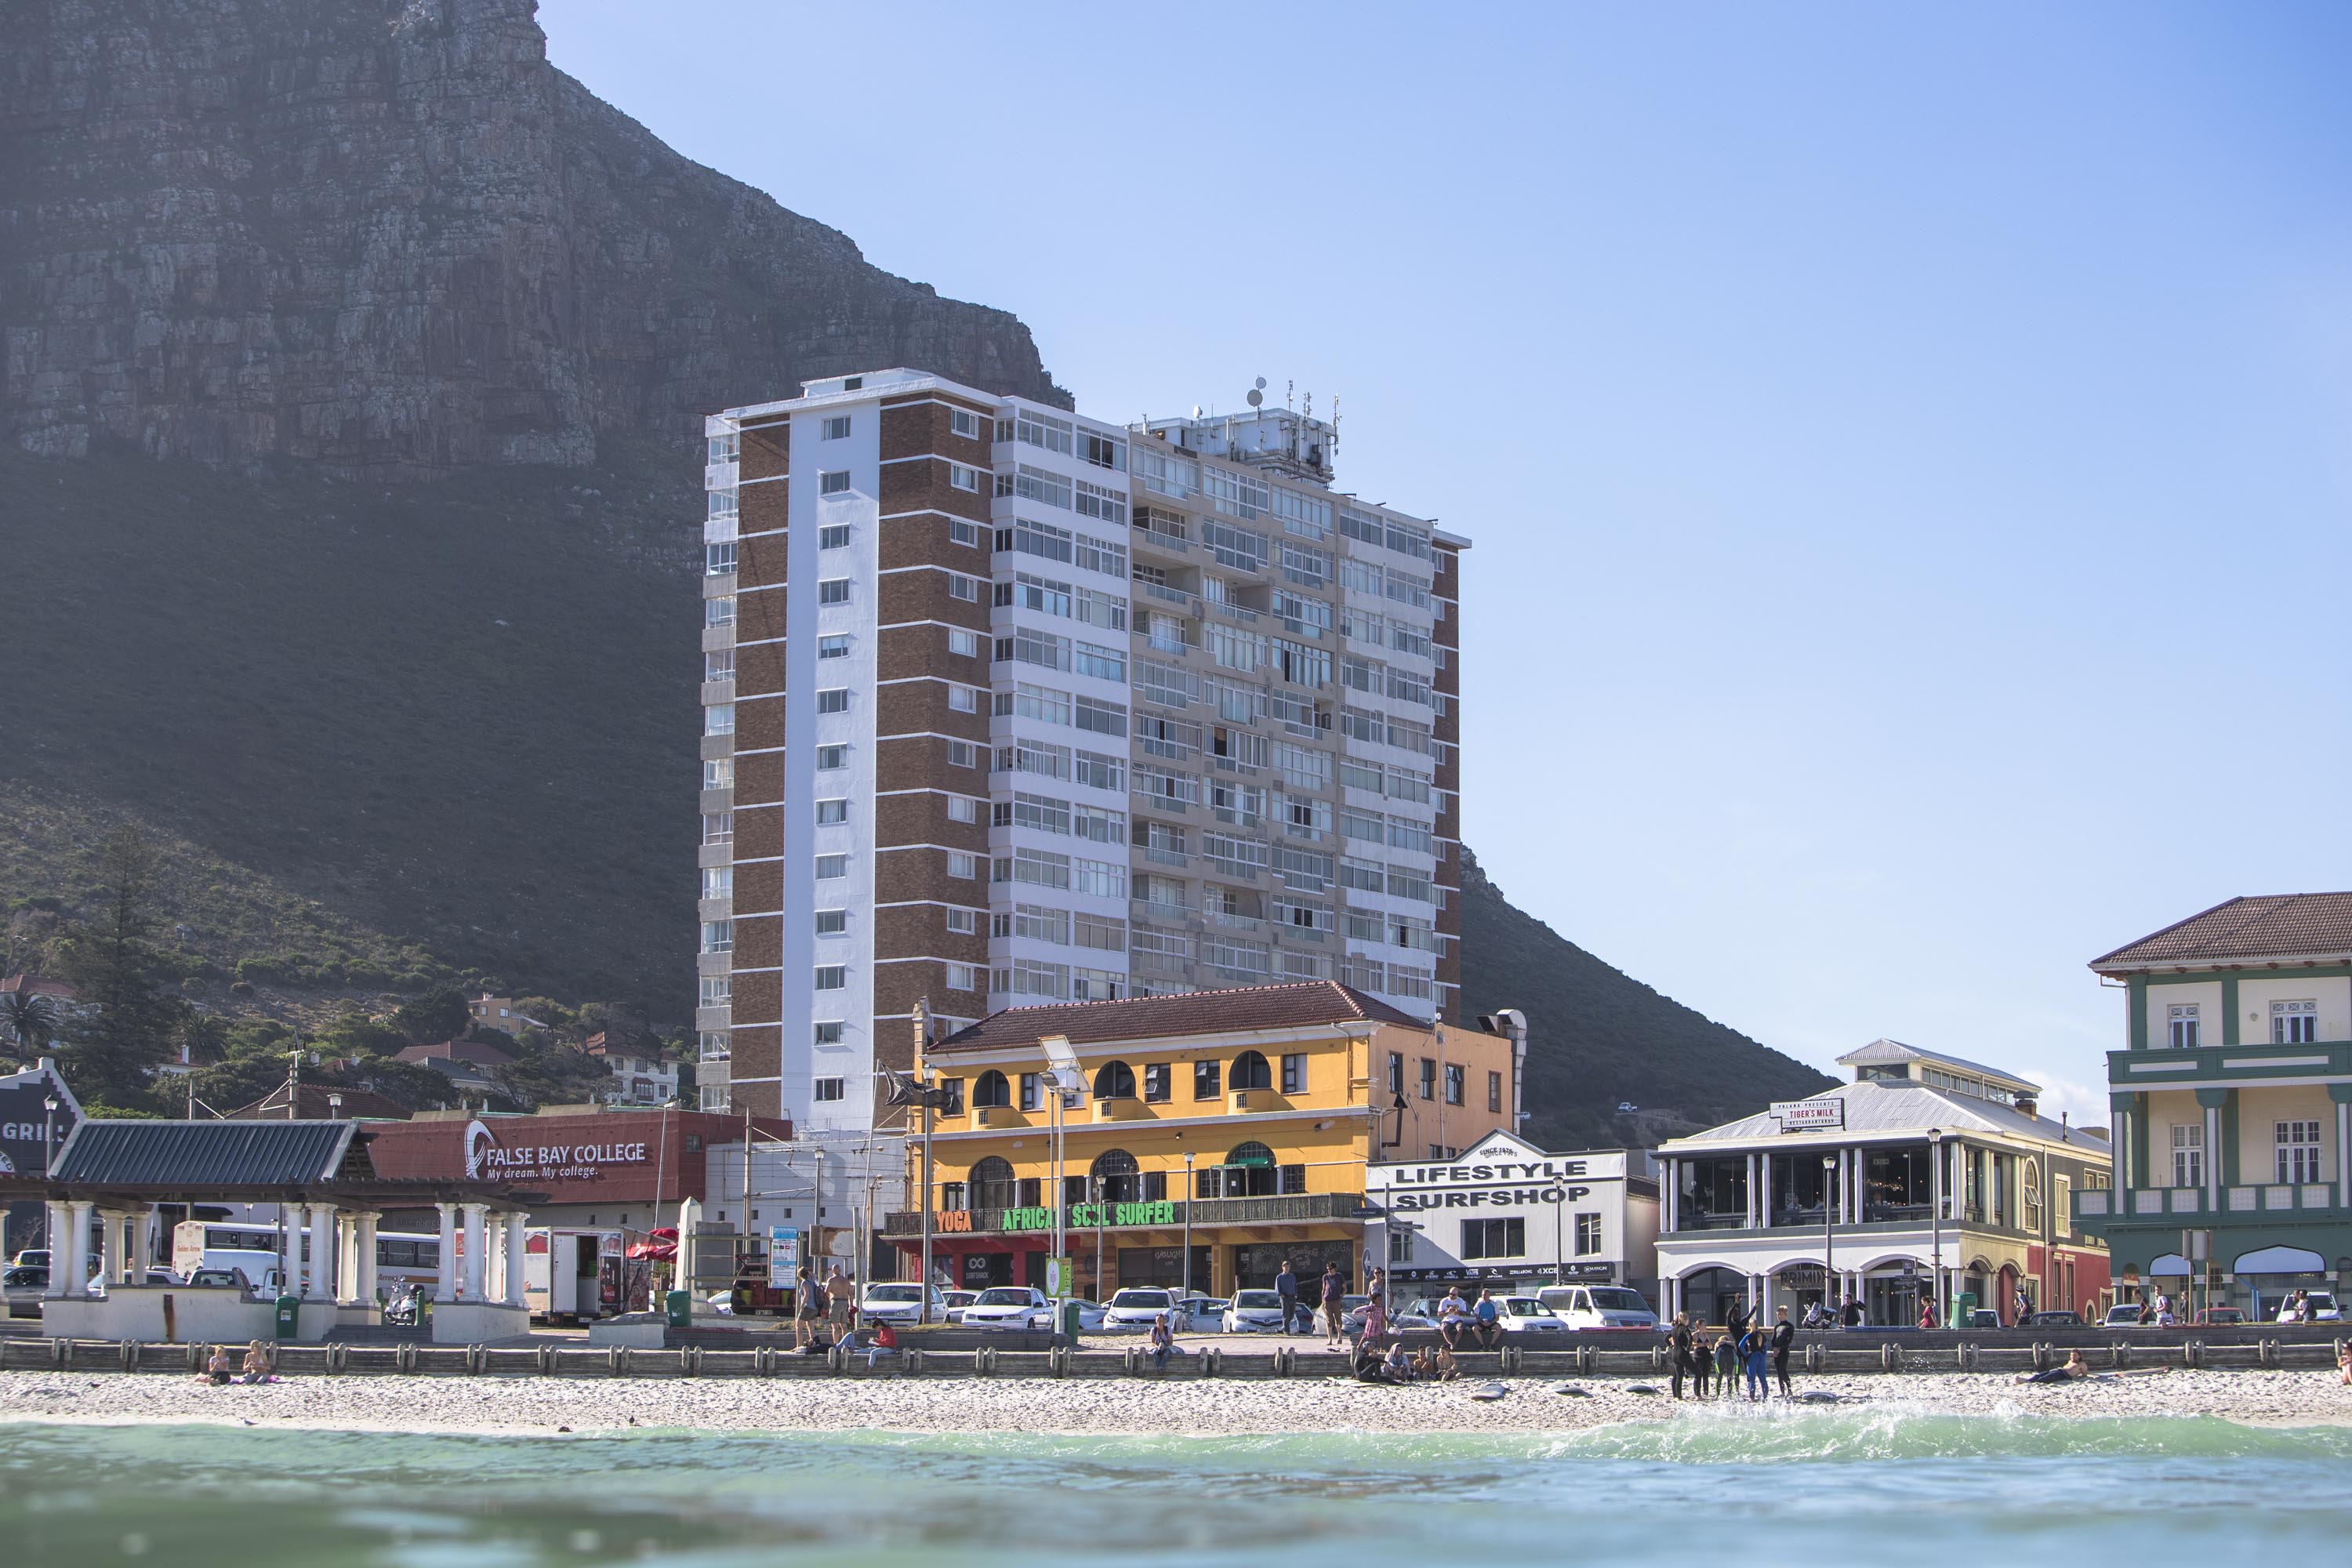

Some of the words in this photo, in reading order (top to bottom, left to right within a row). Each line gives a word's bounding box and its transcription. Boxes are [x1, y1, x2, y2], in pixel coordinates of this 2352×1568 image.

[1790, 1109, 1815, 1119] TIGER'S
[1817, 1109, 1834, 1117] MILK
[487, 1147, 534, 1166] FALSE
[539, 1146, 570, 1164] BAY
[574, 1142, 646, 1163] COLLEGE
[1479, 1147, 1497, 1156] SINCE
[487, 1169, 501, 1181] My
[504, 1167, 539, 1178] dream.
[542, 1167, 556, 1178] My
[560, 1165, 598, 1180] college.
[1396, 1160, 1588, 1184] LIFESTYLE
[1396, 1186, 1591, 1209] SURFSHOP
[936, 1209, 972, 1232] YOGA
[1116, 1202, 1175, 1225] SURFER
[965, 1271, 989, 1279] SURFSHACK
